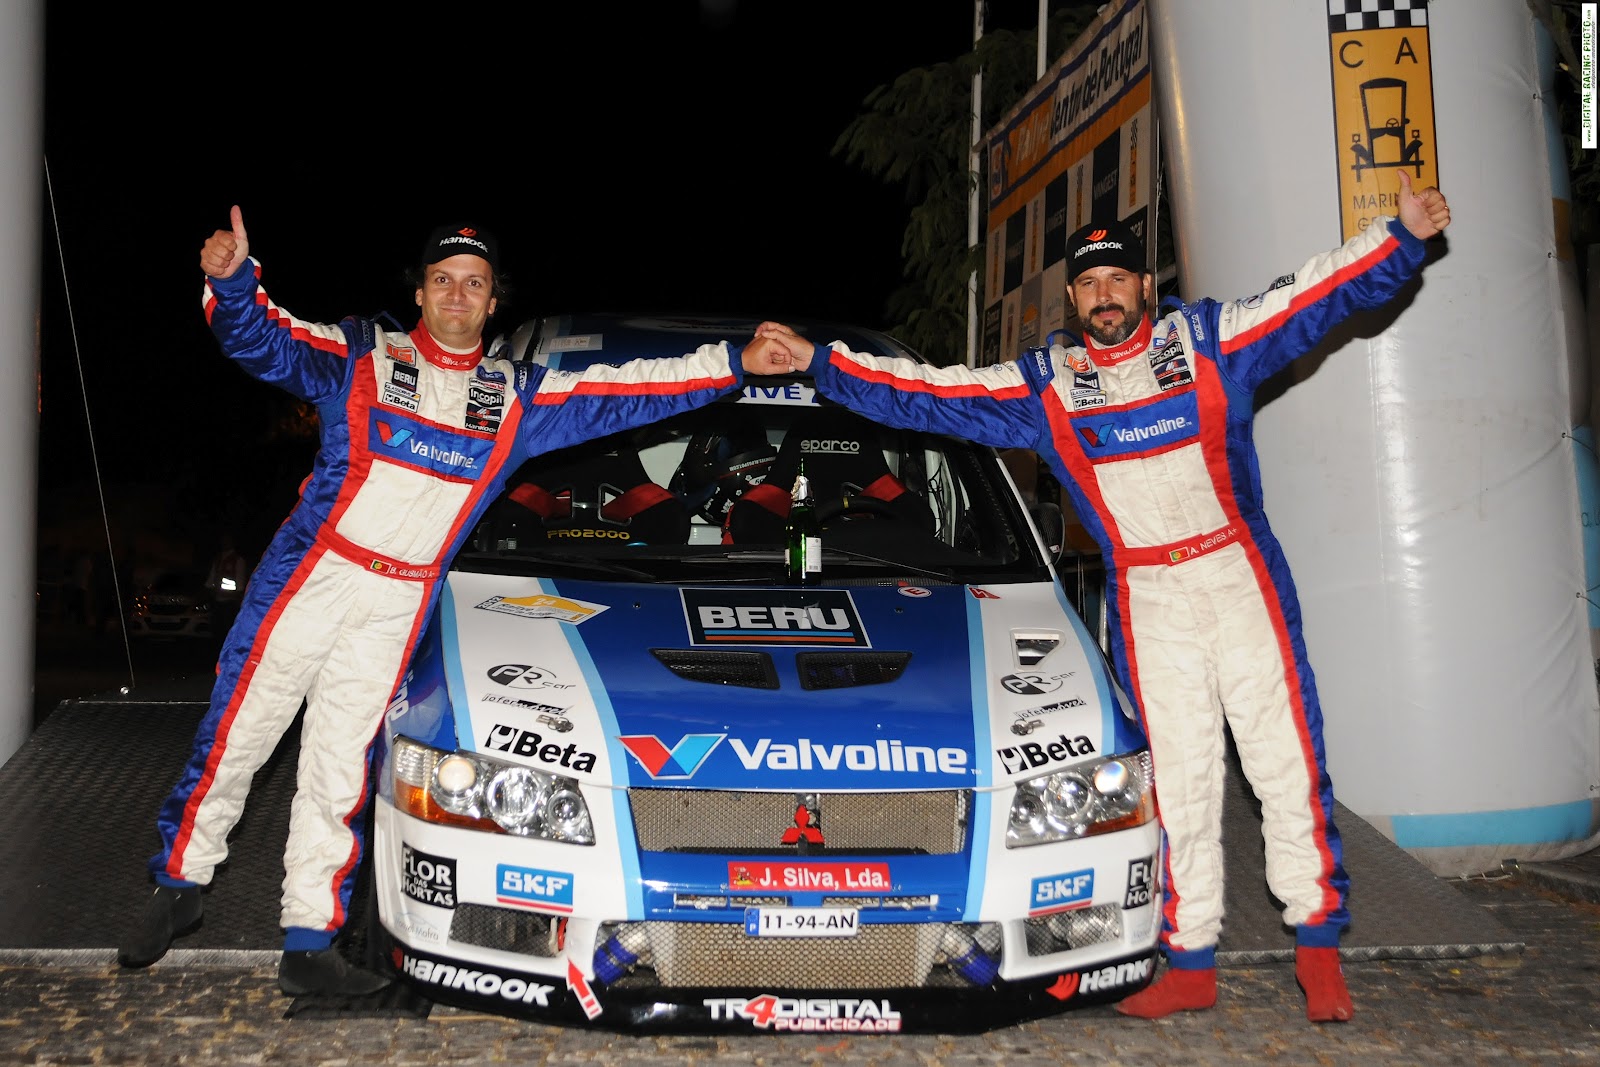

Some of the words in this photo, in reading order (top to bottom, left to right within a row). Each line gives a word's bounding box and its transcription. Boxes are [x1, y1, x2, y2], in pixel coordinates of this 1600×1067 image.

[1097, 7, 1145, 97] Portugal
[1339, 40, 1364, 68] C
[1394, 37, 1418, 64] A
[394, 371, 416, 386] BERU
[394, 397, 416, 410] Beta
[471, 388, 502, 406] Incopil
[1081, 398, 1104, 407] Beta
[1114, 416, 1186, 443] Valvoline
[410, 438, 474, 469] Valvoline
[800, 438, 861, 453] sparco
[546, 527, 631, 540] PRO2000
[1200, 532, 1227, 551] NEVES
[697, 605, 851, 630] BERU
[512, 730, 597, 774] Beta
[728, 738, 967, 775] Valvoline
[1019, 734, 1096, 769] Beta
[403, 850, 452, 887] FLOR
[759, 867, 778, 886] J.
[784, 867, 840, 890] Silva,
[845, 867, 889, 888] Lda.
[402, 878, 454, 906] HORTAS
[414, 877, 427, 888] DAS
[503, 870, 568, 897] SKF
[1035, 874, 1092, 902] SKF
[764, 913, 855, 929] 11-94-AN
[774, 1017, 901, 1032] PUBLICIDADE
